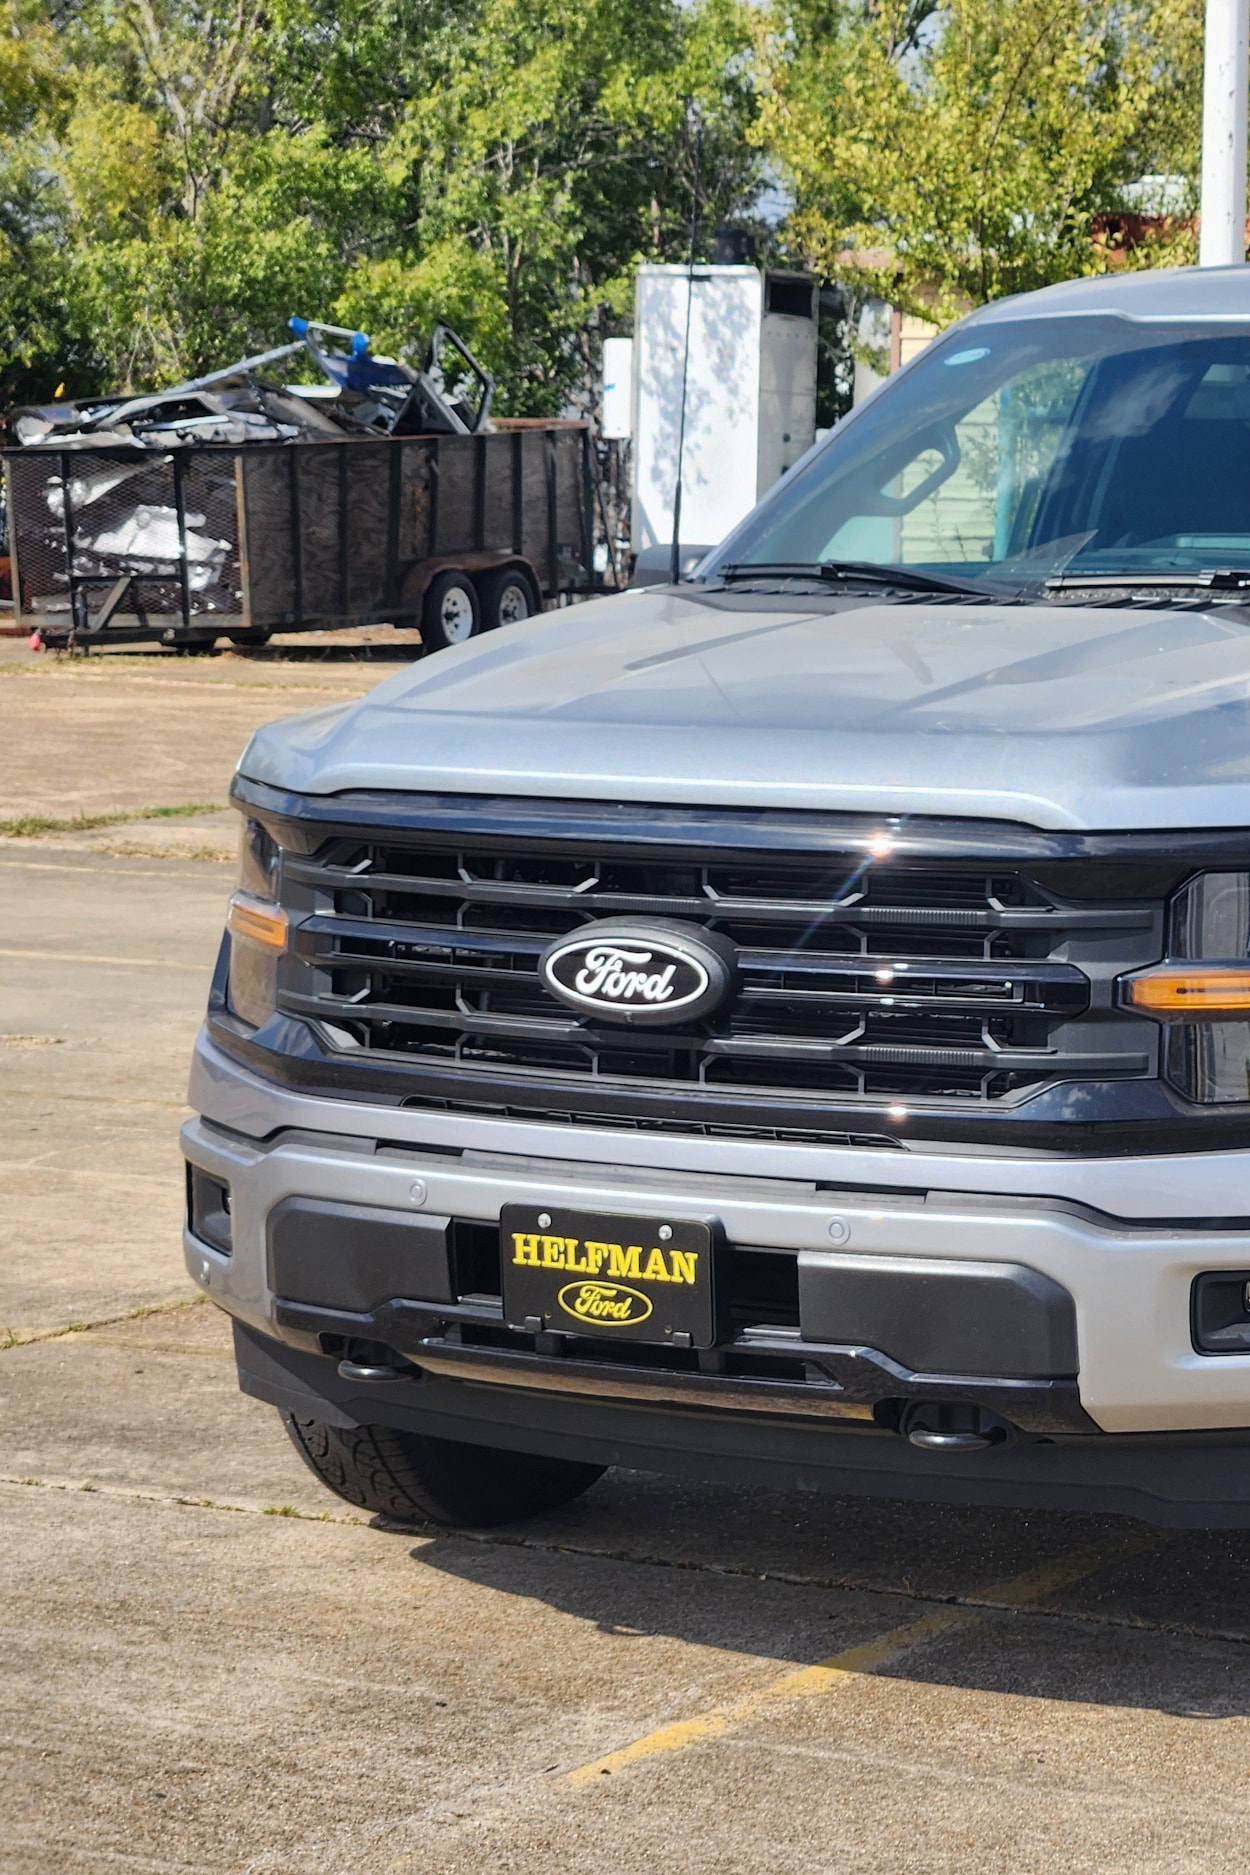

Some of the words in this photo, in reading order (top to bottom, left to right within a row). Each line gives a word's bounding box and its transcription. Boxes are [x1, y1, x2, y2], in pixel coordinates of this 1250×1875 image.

[575, 945, 677, 1001] Ford
[511, 1232, 699, 1285] HELFMAN
[574, 1285, 632, 1320] Ford
